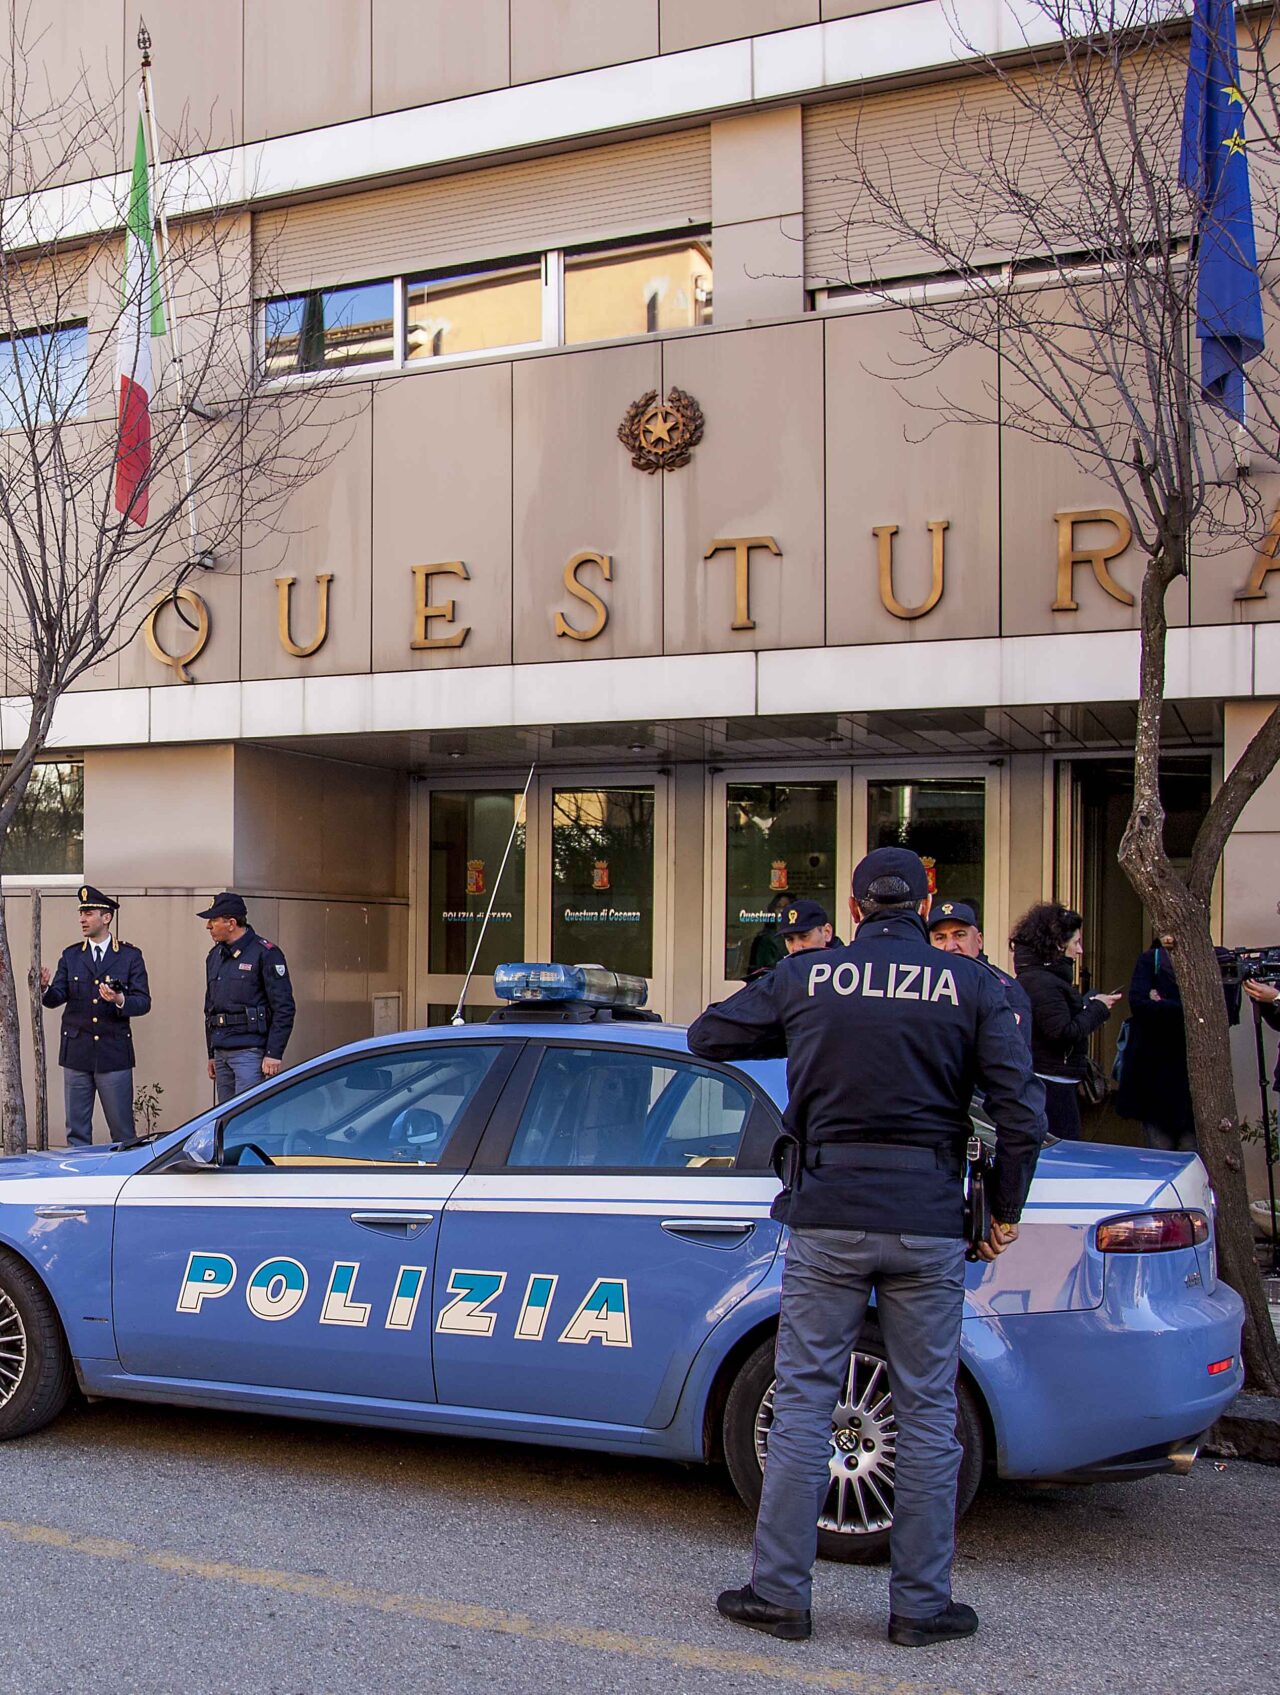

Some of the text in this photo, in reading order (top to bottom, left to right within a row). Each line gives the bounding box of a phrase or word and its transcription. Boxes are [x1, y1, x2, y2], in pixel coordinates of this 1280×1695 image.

[442, 911, 474, 922] POLIZIA
[477, 911, 485, 922] di
[564, 908, 641, 921] Questura di Cosenza
[739, 909, 776, 923] Questura
[807, 962, 960, 1006] POLIZIA
[175, 1250, 634, 1349] POLIZIA
